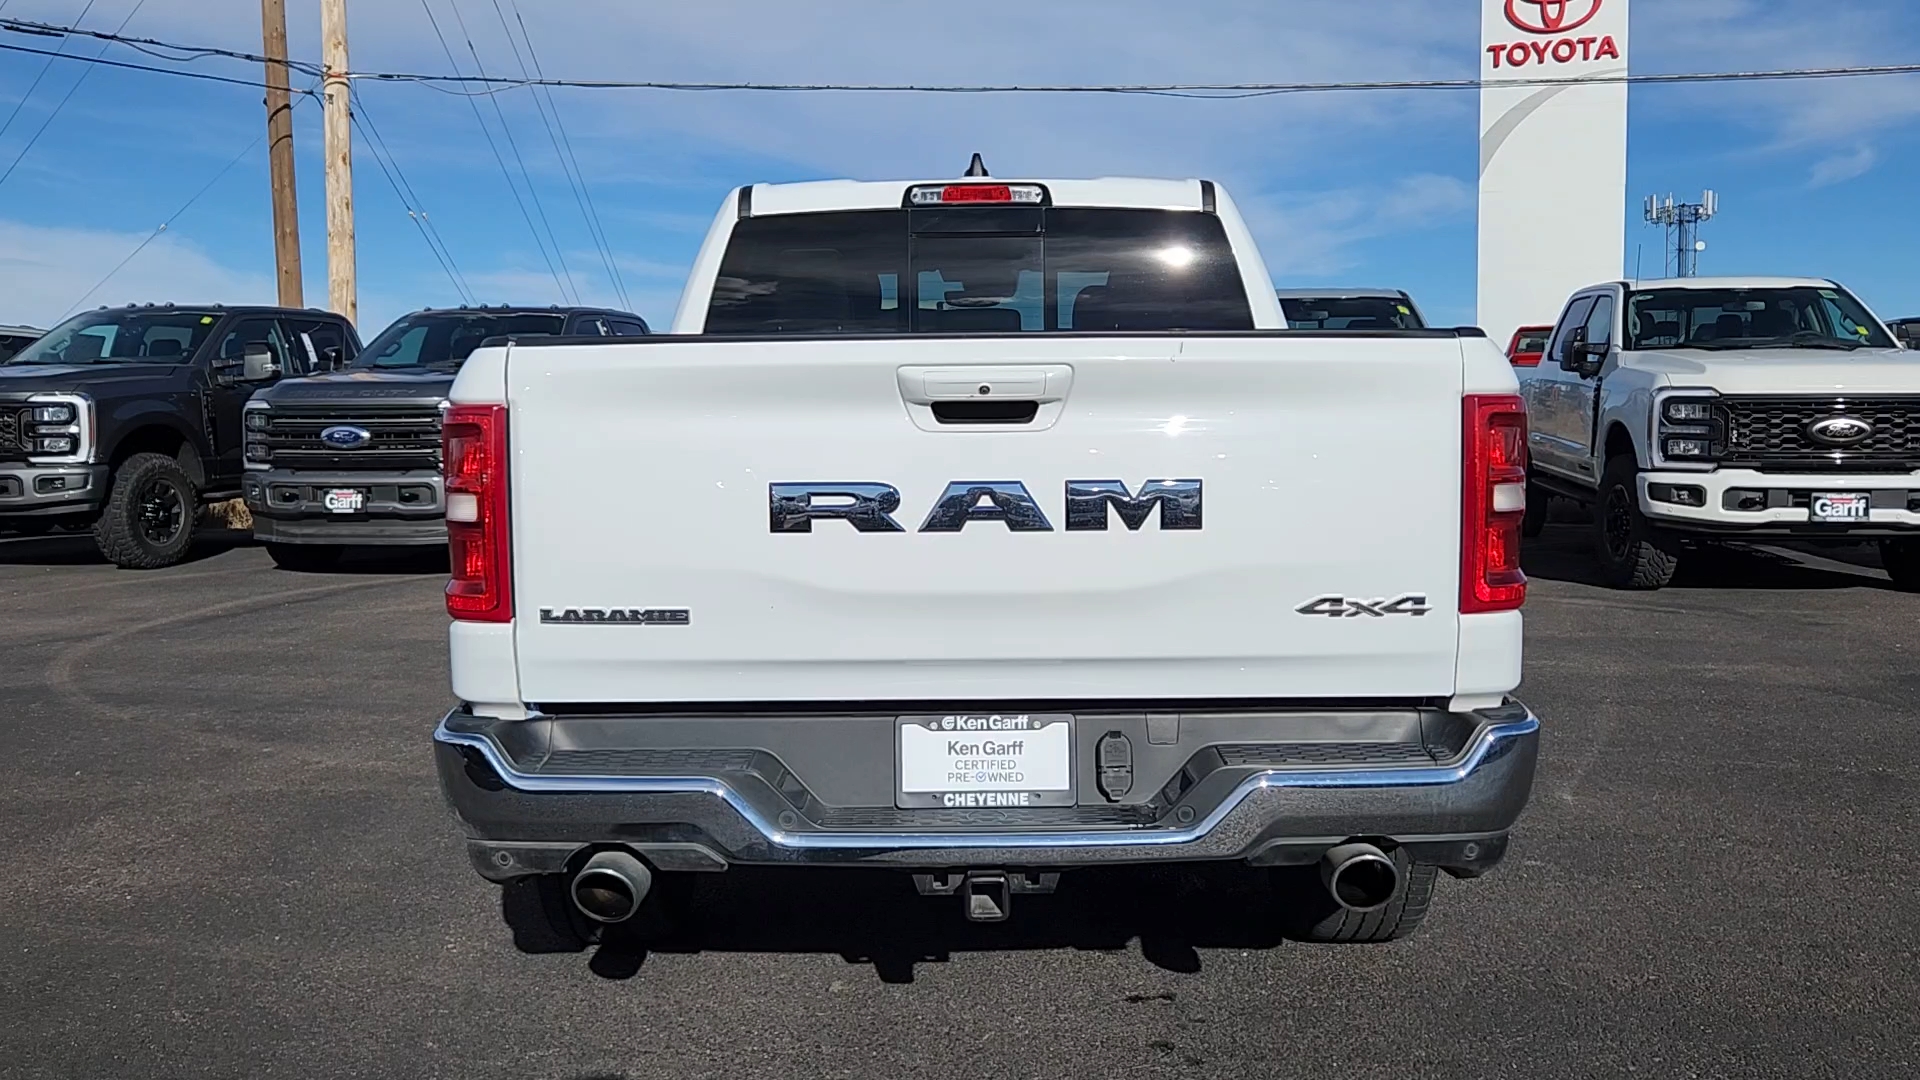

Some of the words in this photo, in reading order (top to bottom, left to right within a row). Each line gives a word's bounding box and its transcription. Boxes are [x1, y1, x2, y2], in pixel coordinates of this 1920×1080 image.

[1486, 35, 1620, 69] TOYOTA
[1826, 423, 1858, 437] Ford
[325, 493, 362, 509] Garff
[769, 479, 1203, 533] RAM
[1814, 498, 1867, 517] Garff
[540, 608, 690, 625] LARAMIE
[989, 715, 1029, 730] Garff
[947, 741, 979, 756] Ken
[983, 740, 1024, 756] Garff
[955, 759, 1016, 770] CERTIFIED
[943, 792, 1029, 807] CHEYENNE
